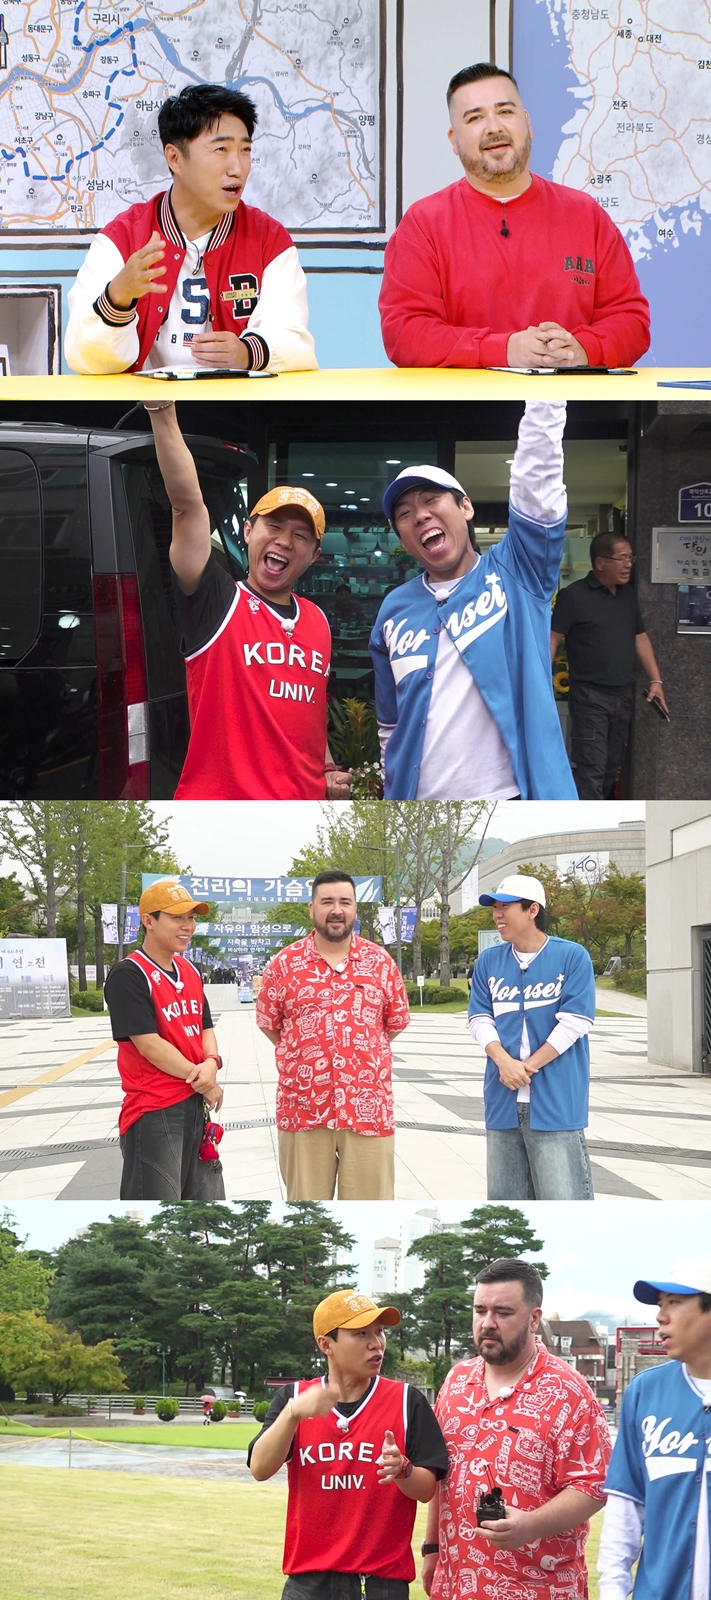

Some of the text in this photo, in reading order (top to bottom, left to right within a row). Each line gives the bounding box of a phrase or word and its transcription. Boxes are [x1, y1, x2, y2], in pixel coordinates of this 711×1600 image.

[92, 14, 120, 25] 구리시
[572, 9, 609, 20] 충청남도
[28, 25, 53, 33] 동대문구
[616, 30, 632, 39] 세종
[646, 34, 662, 43] 대전
[22, 54, 40, 62] 성동구
[100, 56, 119, 64] 강동구
[82, 90, 101, 99] 송파구
[136, 100, 163, 111] 하남시
[612, 100, 628, 110] 전주
[34, 112, 54, 120] 강남구
[358, 115, 375, 126] 양평
[616, 122, 654, 133] 전라북도
[14, 136, 34, 144] 서초구
[596, 174, 612, 184] 광주
[86, 180, 114, 190] 성남시
[70, 204, 84, 213] 판교
[658, 228, 674, 238] 여수
[564, 256, 594, 274] AAA
[269, 679, 316, 704] UNIV.
[190, 878, 252, 896] 진리의
[214, 924, 292, 934] 자유의 함성으로
[321, 1474, 366, 1490] UNIV.
